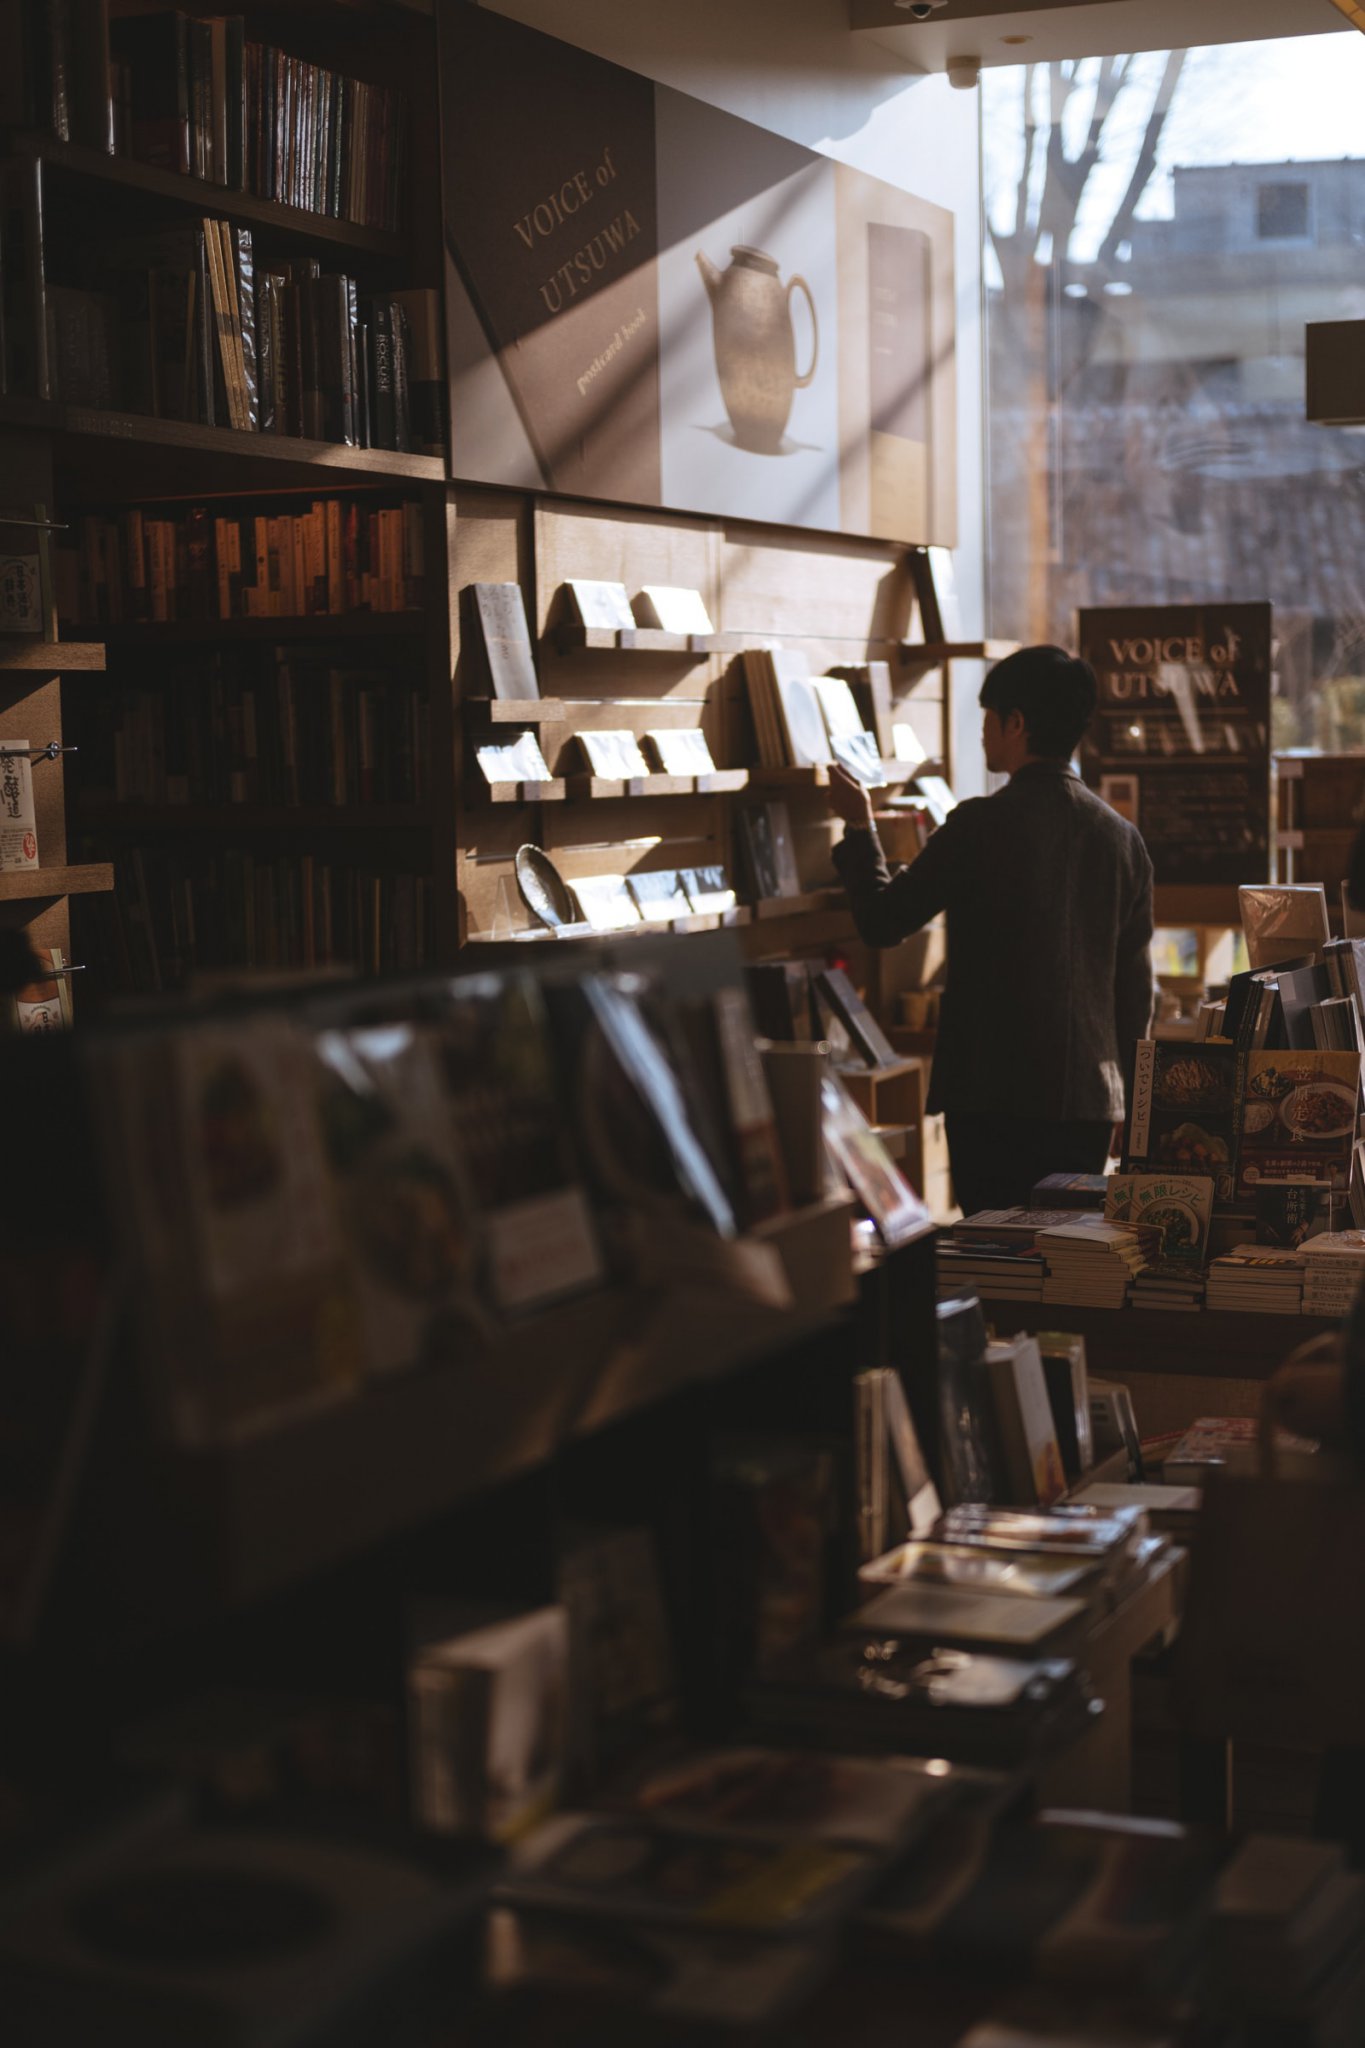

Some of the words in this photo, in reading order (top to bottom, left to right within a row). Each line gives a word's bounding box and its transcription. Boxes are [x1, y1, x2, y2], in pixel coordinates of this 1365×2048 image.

[513, 171, 593, 249] VOICE
[595, 147, 618, 188] of
[539, 209, 641, 313] UTSUWA
[575, 331, 623, 396] postcard
[1107, 636, 1204, 665] VOICE
[1209, 626, 1241, 663] of
[1290, 1065, 1312, 1143] 笠原定食
[1140, 1184, 1205, 1208] 無限レシピ
